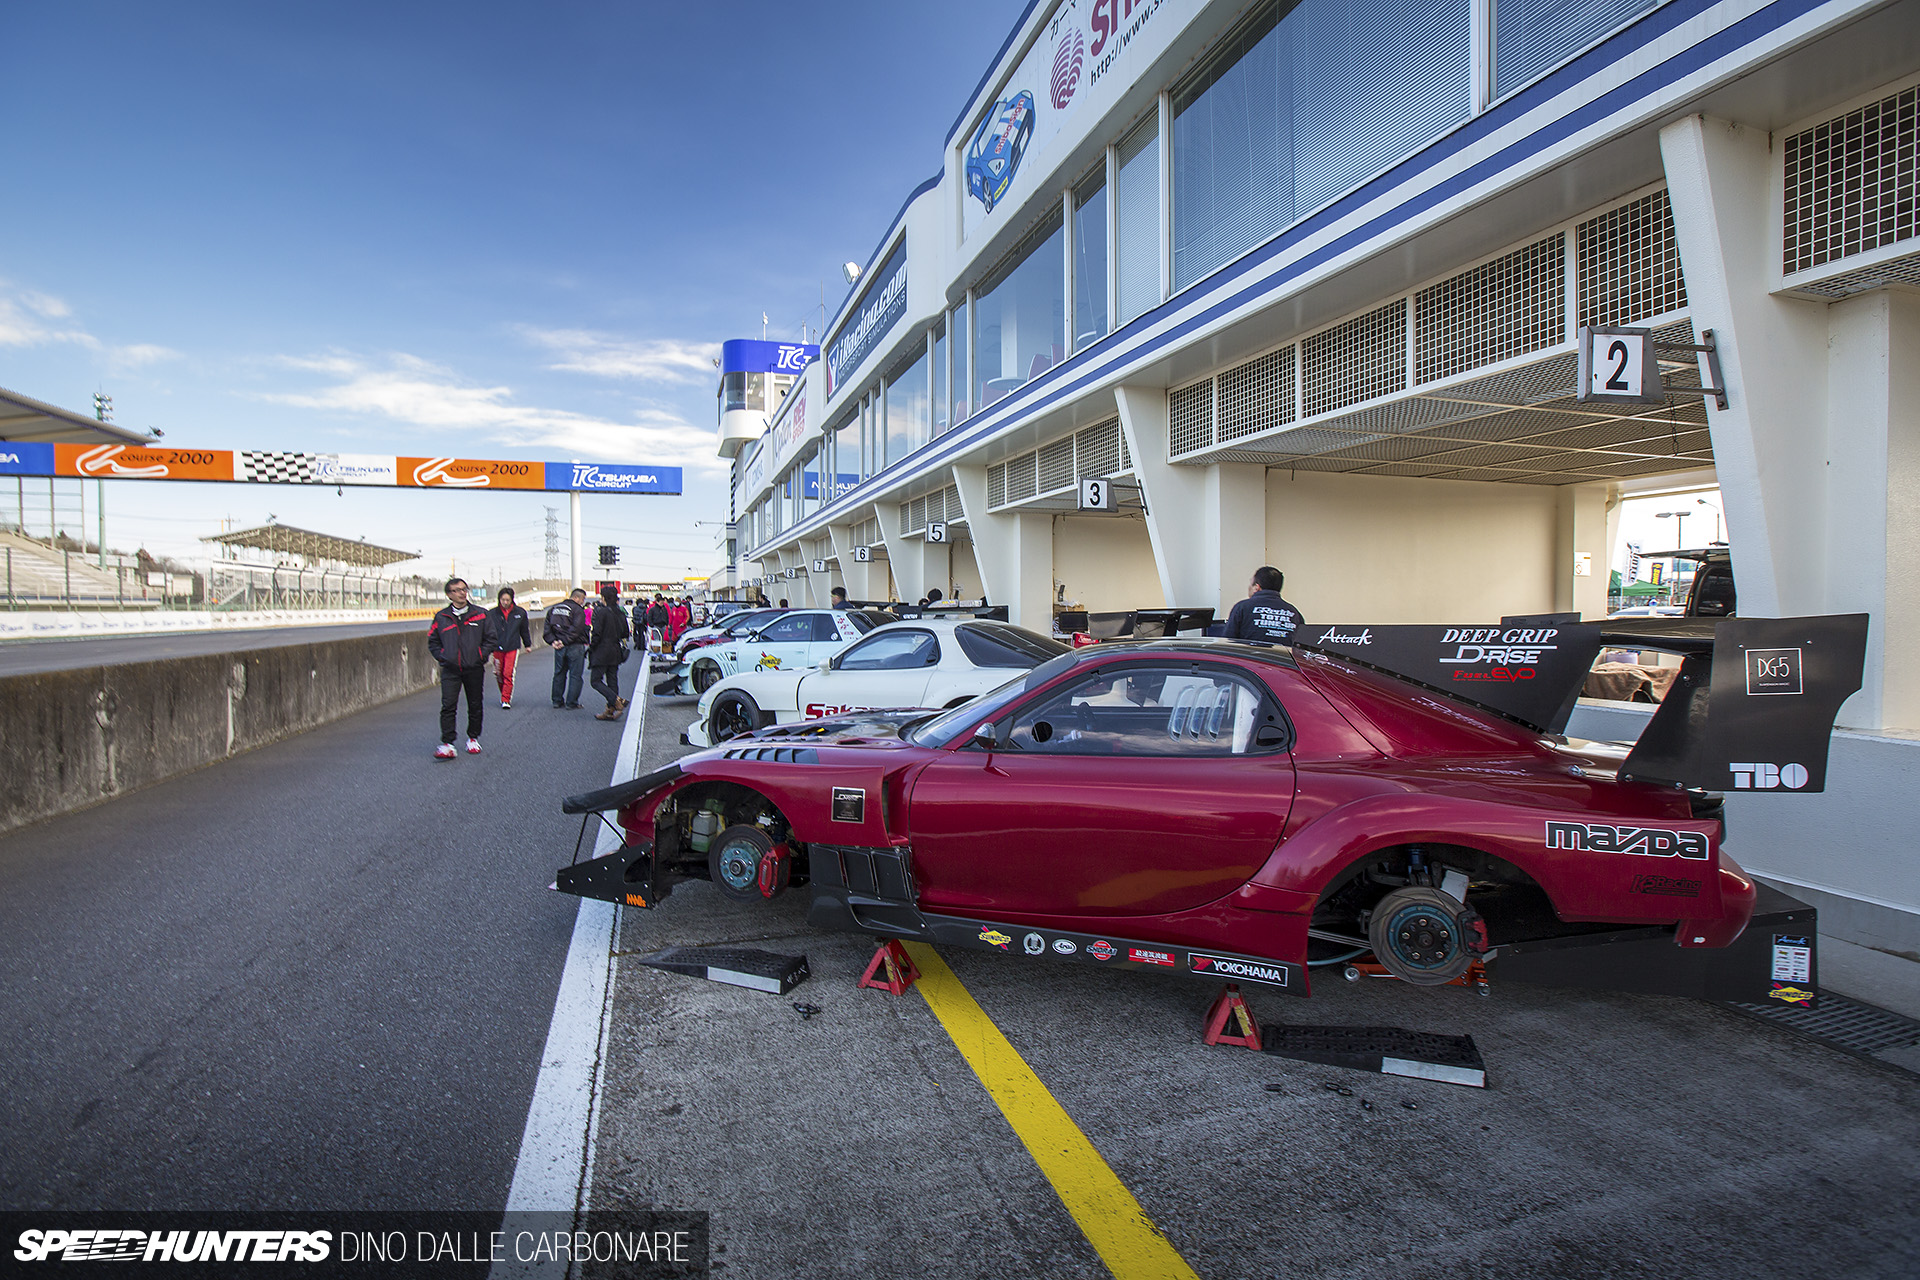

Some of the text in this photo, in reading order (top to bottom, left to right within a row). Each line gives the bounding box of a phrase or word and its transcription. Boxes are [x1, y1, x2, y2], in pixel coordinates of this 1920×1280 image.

[839, 264, 907, 367] iRacing.com
[867, 290, 906, 345] SIMULATIONS
[1605, 339, 1630, 391] 2
[119, 451, 215, 465] course 2000
[450, 463, 529, 476] course 2000
[597, 473, 658, 484] TSUKUBA
[1089, 482, 1101, 506] 3
[931, 525, 943, 541] 5
[859, 548, 866, 560] 6
[817, 562, 823, 571] 7
[1253, 619, 1297, 629] TUNE-UP
[1260, 613, 1291, 622] TOTAL
[1317, 625, 1373, 646] Attack
[1440, 628, 1559, 643] DEEP GRIP
[1757, 656, 1790, 678] DG5
[1729, 762, 1810, 789] TBO
[1545, 820, 1710, 861] mazda
[1213, 960, 1282, 982] YOKOHAMA
[1770, 990, 1812, 999] SUNOCO
